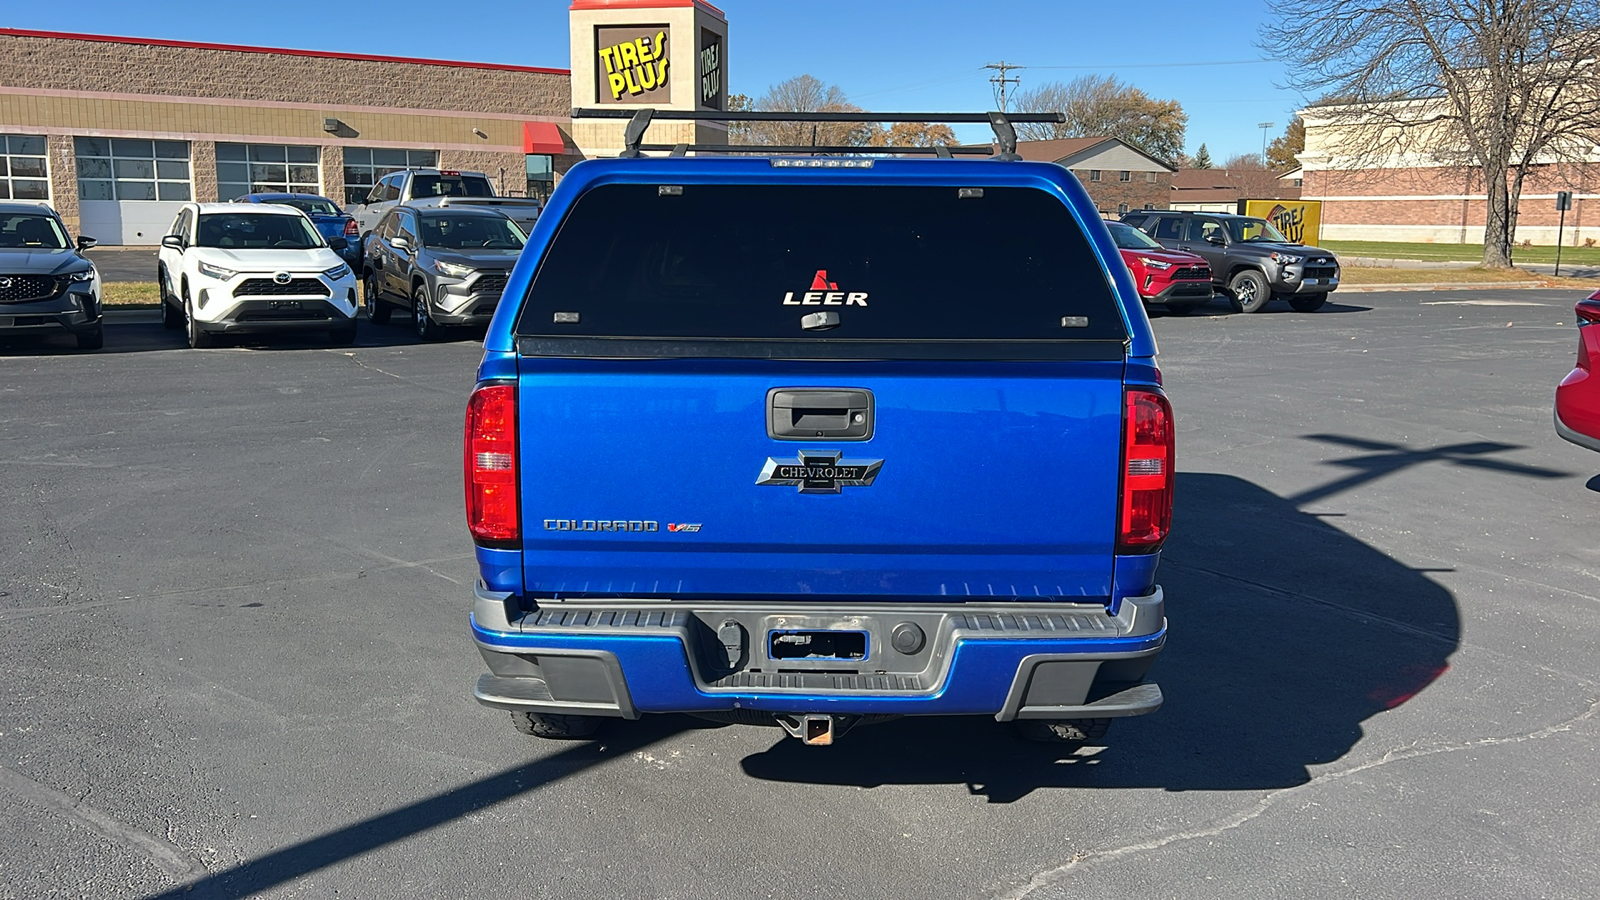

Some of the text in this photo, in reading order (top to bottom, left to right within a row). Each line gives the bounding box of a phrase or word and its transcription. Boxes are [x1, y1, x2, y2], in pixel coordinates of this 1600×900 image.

[599, 31, 667, 74] TIRES
[700, 43, 719, 76] TIRES
[608, 57, 670, 100] PLUS
[702, 68, 720, 102] PLUS
[1273, 205, 1305, 231] TIRES
[782, 291, 869, 307] LEER
[780, 467, 859, 478] CHEVROLET
[543, 519, 659, 532] COLORADO
